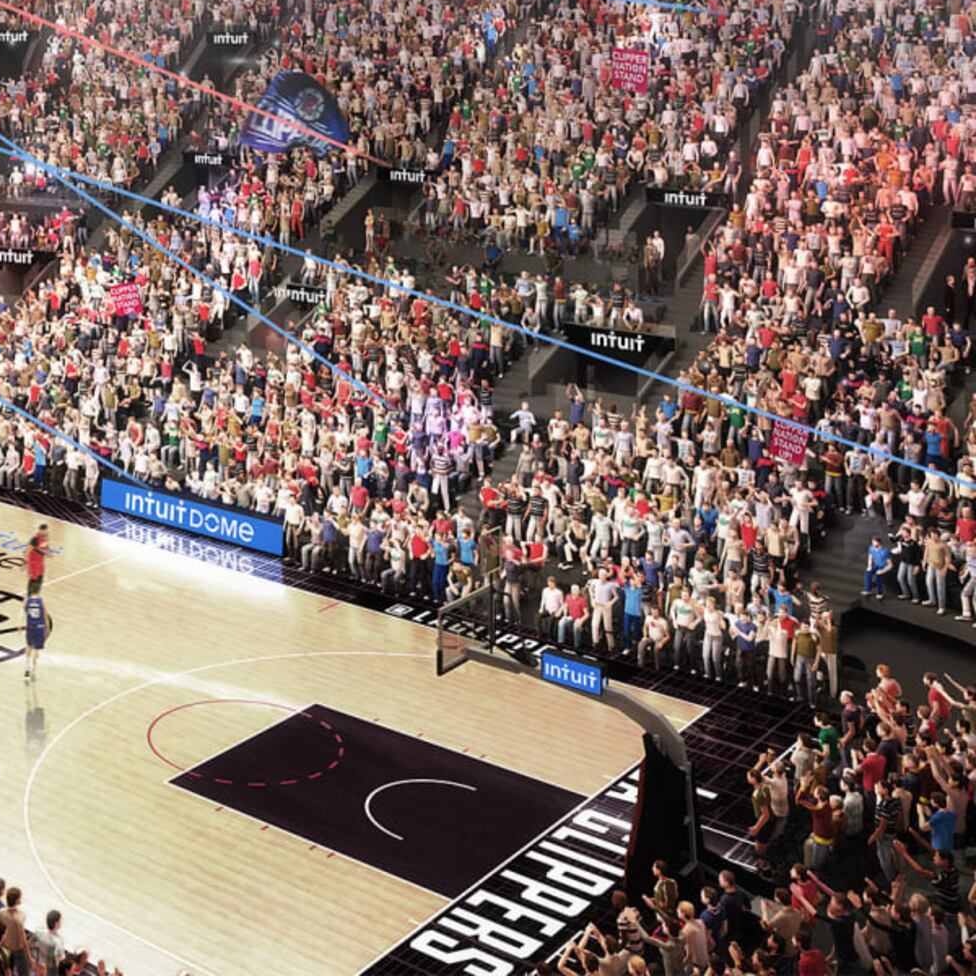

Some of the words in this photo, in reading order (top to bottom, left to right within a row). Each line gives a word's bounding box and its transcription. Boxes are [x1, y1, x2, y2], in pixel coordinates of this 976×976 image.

[214, 32, 248, 44] intuit
[195, 154, 222, 165] intuit
[390, 169, 425, 182] intuit
[664, 192, 706, 206] intuit
[591, 332, 645, 352] intuit
[126, 492, 186, 525] intuit
[545, 663, 597, 689] intuit
